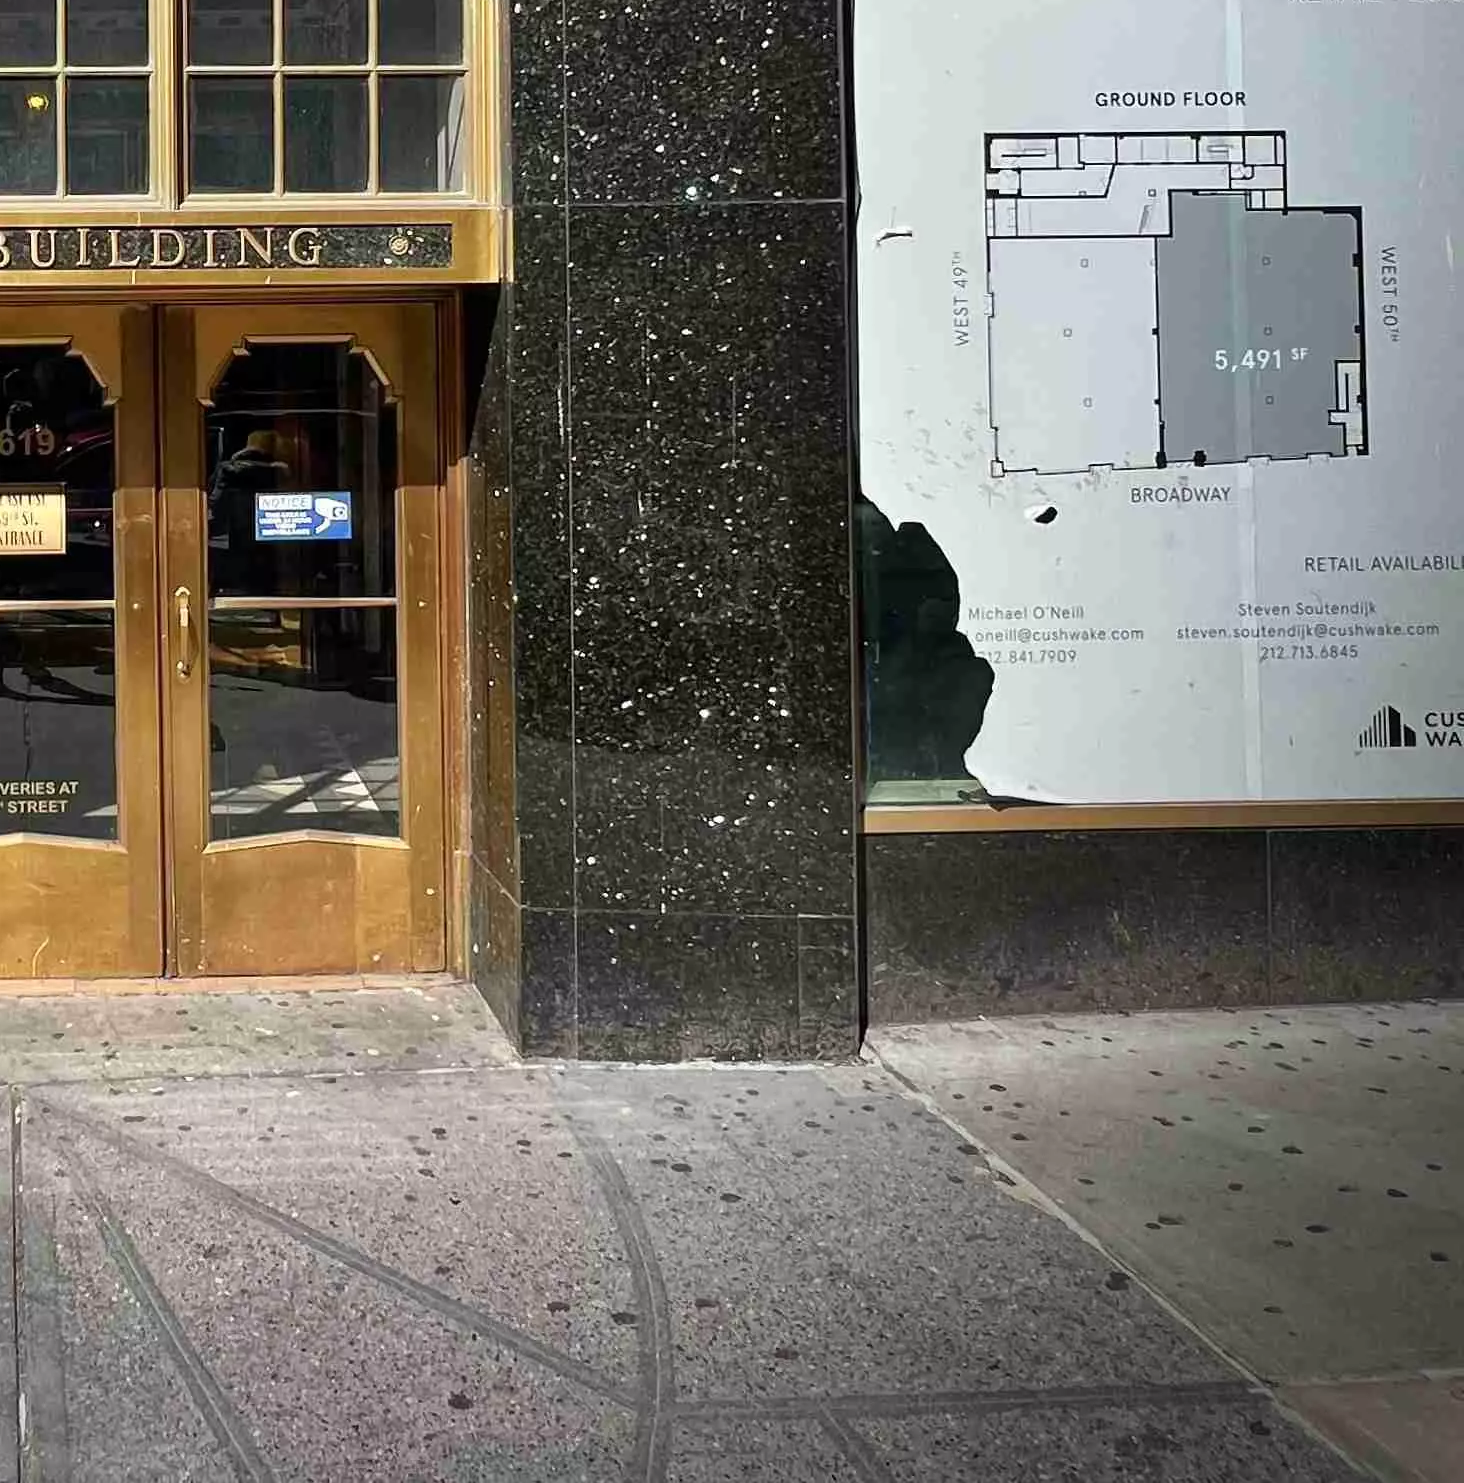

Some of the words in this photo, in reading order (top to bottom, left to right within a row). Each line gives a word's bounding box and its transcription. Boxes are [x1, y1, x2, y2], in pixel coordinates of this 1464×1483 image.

[1095, 91, 1176, 107] GROUND
[1184, 91, 1247, 106] FLOOR
[1381, 246, 1398, 296] WEST
[953, 296, 969, 346] WEST
[1215, 349, 1281, 372] 5,491
[1291, 347, 1309, 360] SF
[1130, 487, 1231, 503] BROADWAY
[1304, 557, 1365, 572] RETAIL
[968, 607, 1027, 621] Michael
[1238, 602, 1291, 617] Steven
[1295, 600, 1377, 617] Soutendijk
[1260, 644, 1359, 661] 212.713.6845
[1425, 731, 1462, 747] WA
[58, 781, 80, 795] AT
[7, 800, 69, 813] STREET
